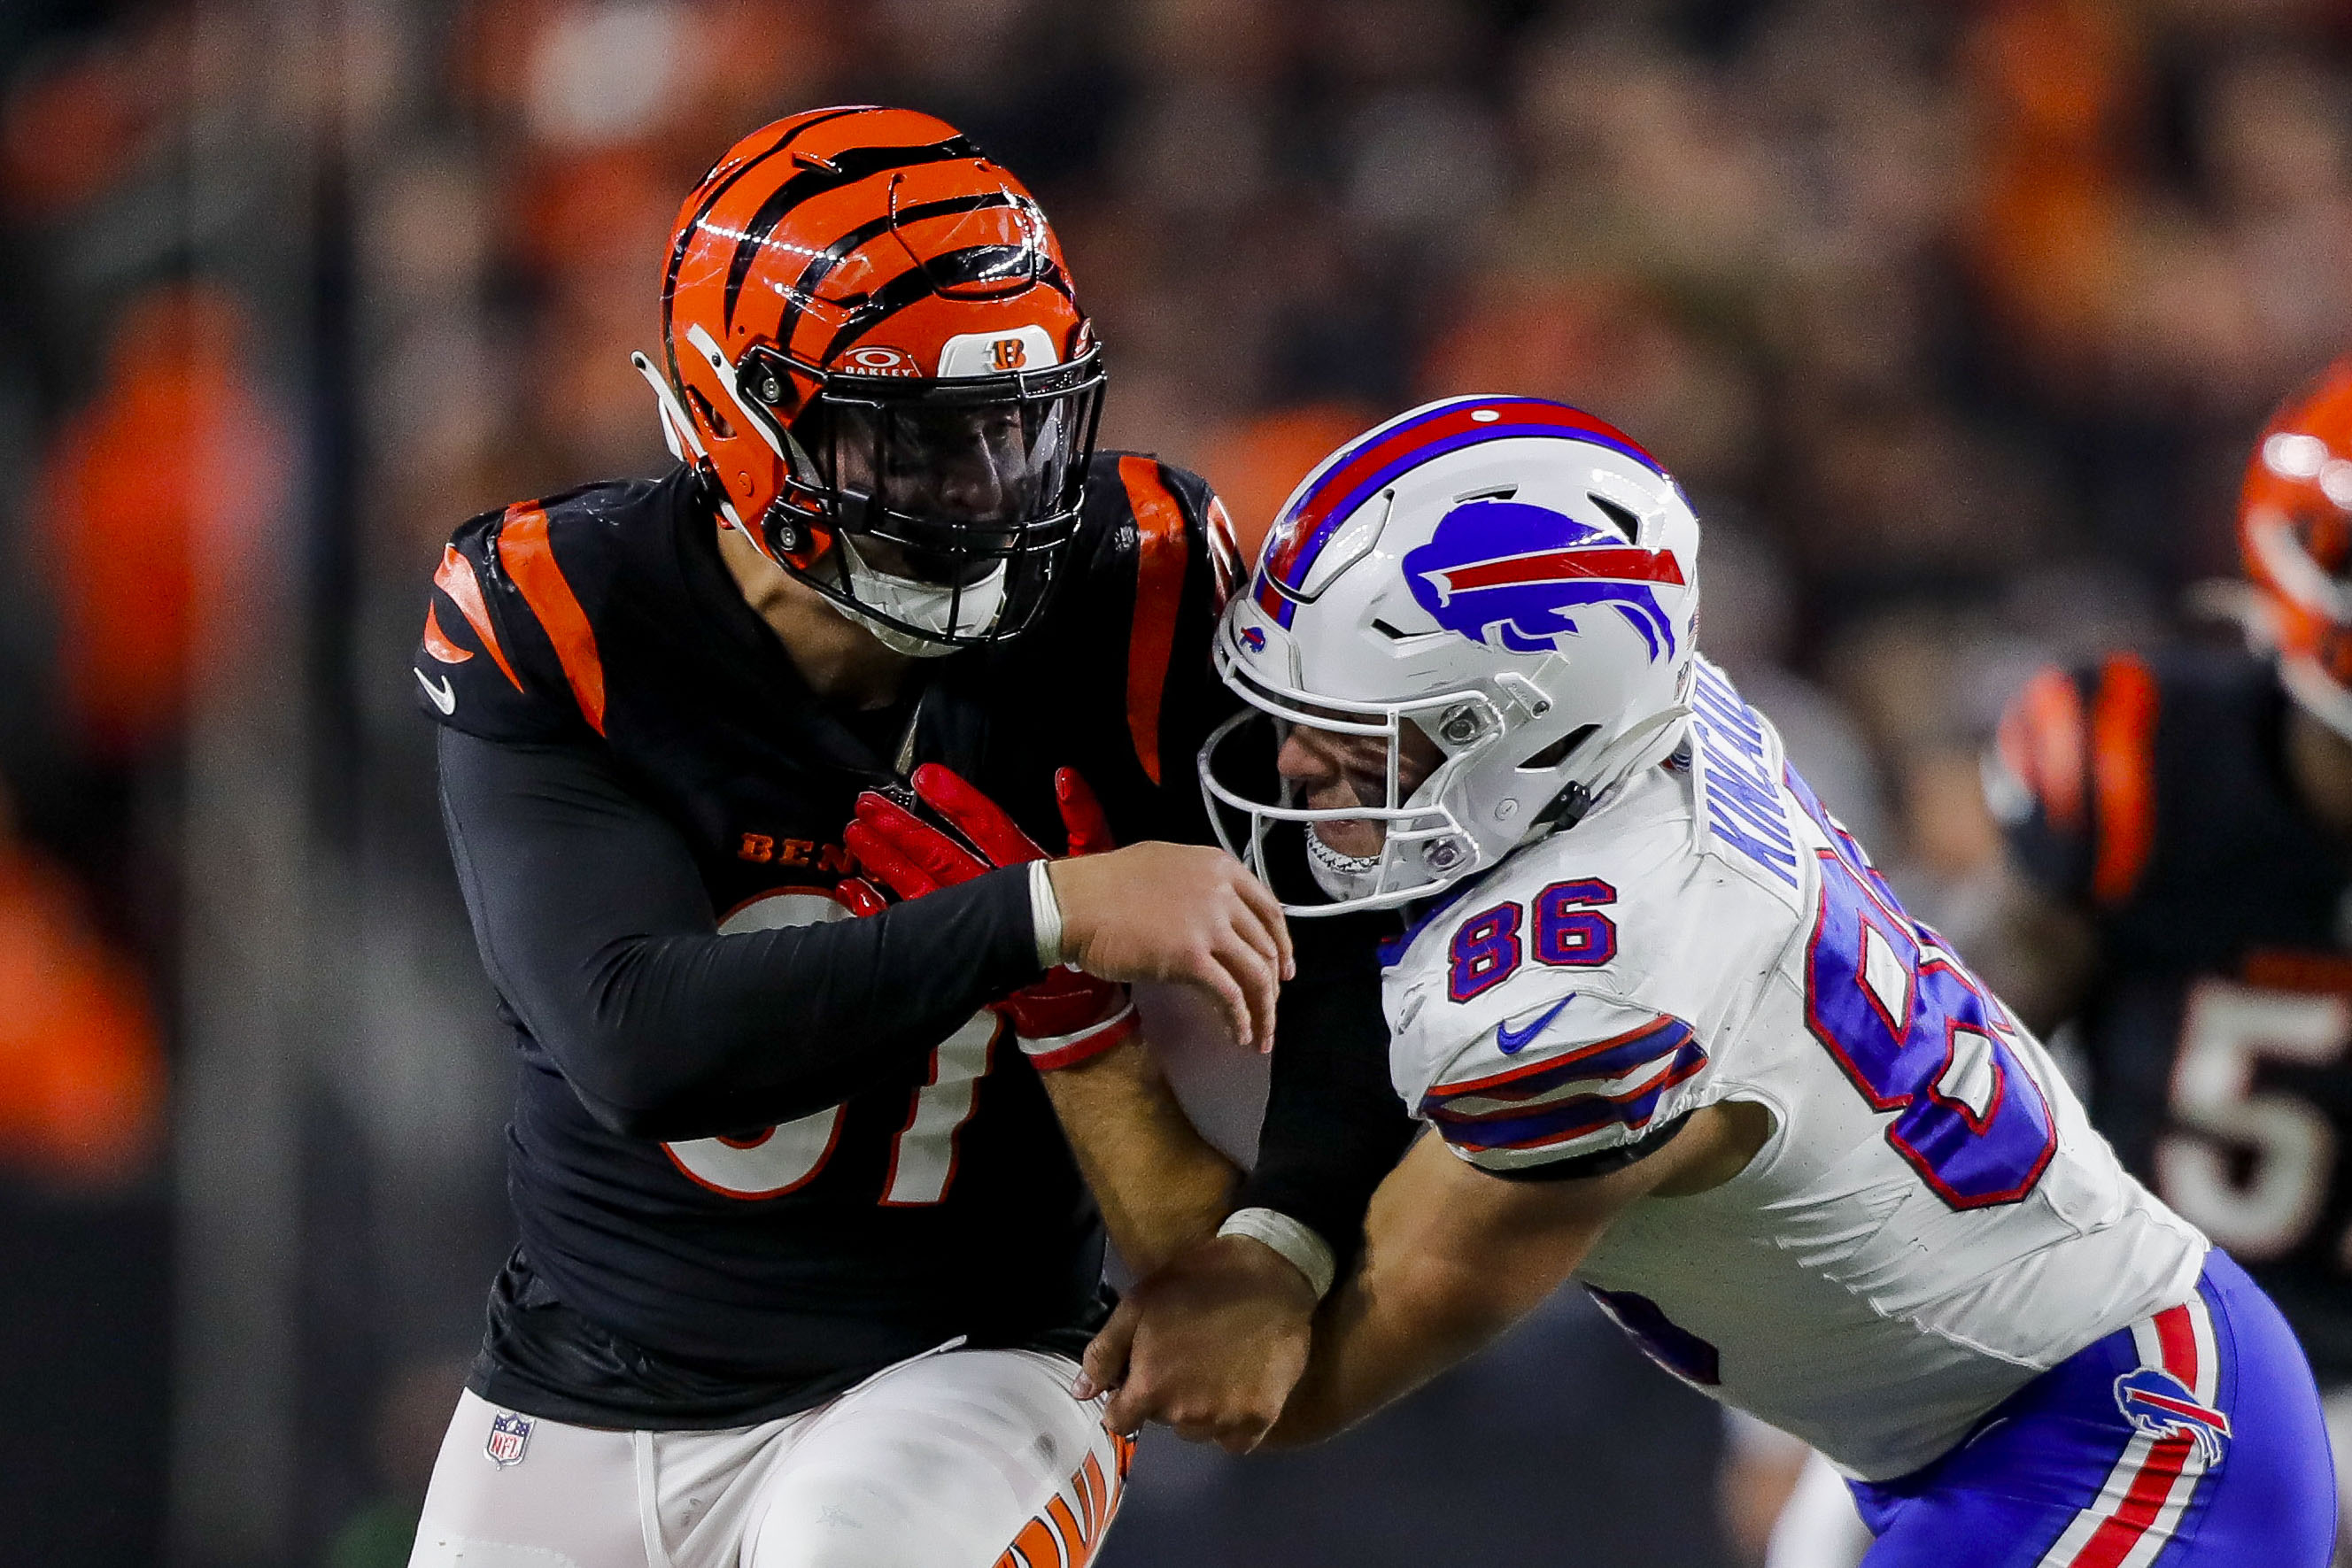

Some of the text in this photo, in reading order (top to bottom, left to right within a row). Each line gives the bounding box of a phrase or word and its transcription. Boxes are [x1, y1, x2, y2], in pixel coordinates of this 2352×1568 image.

[845, 366, 911, 377] OAKLEY
[1447, 877, 1618, 1003] 86
[490, 1432, 519, 1458] NFL
